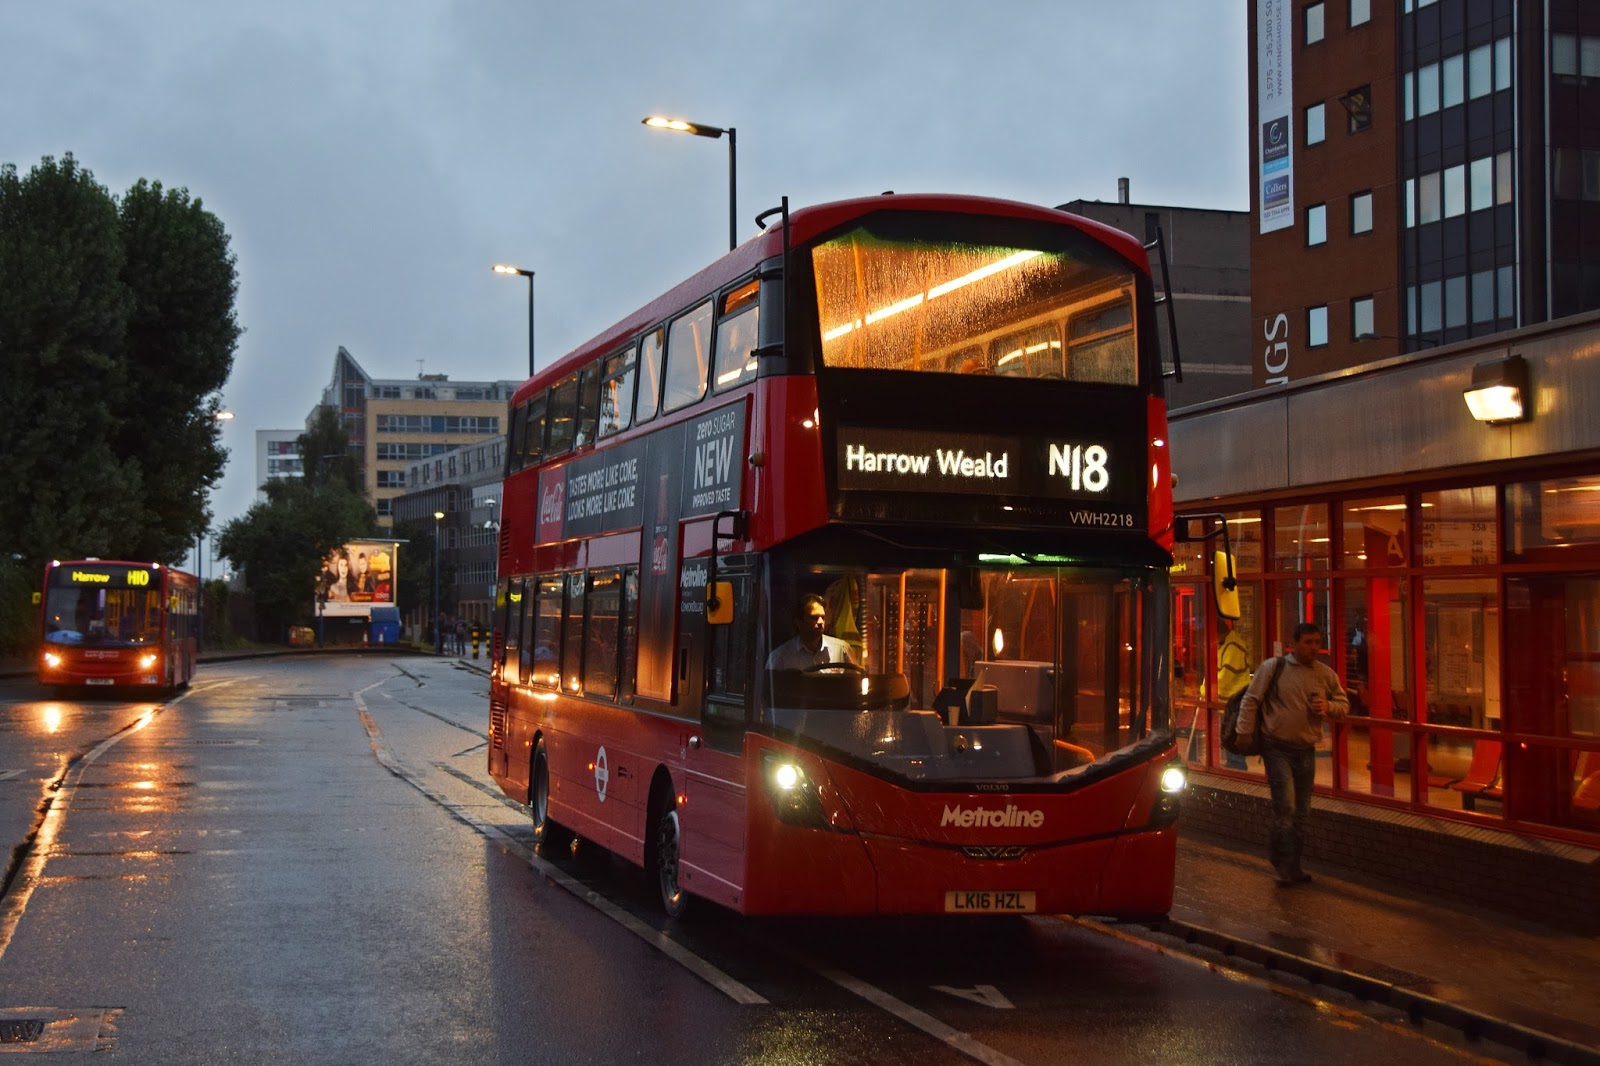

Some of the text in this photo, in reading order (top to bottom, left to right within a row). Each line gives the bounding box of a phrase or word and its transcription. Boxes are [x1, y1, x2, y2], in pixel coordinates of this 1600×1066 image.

[1265, 183, 1287, 195] Colliers
[713, 412, 735, 435] SUGAR
[694, 435, 734, 490] NEW
[846, 444, 1008, 478] Harrow Weald
[1048, 444, 1109, 492] N18
[569, 458, 638, 497] TASTES MORE LIKE COKE,
[568, 485, 636, 521] LOOKS MORE LIKE COKE
[692, 487, 731, 508] IMPROVED TASTE
[1070, 511, 1133, 526] VWH2218
[72, 571, 110, 583] Harrow
[680, 564, 707, 588] Metroline
[940, 804, 1044, 828] Metroline
[954, 893, 1025, 909] LK16 HZL
